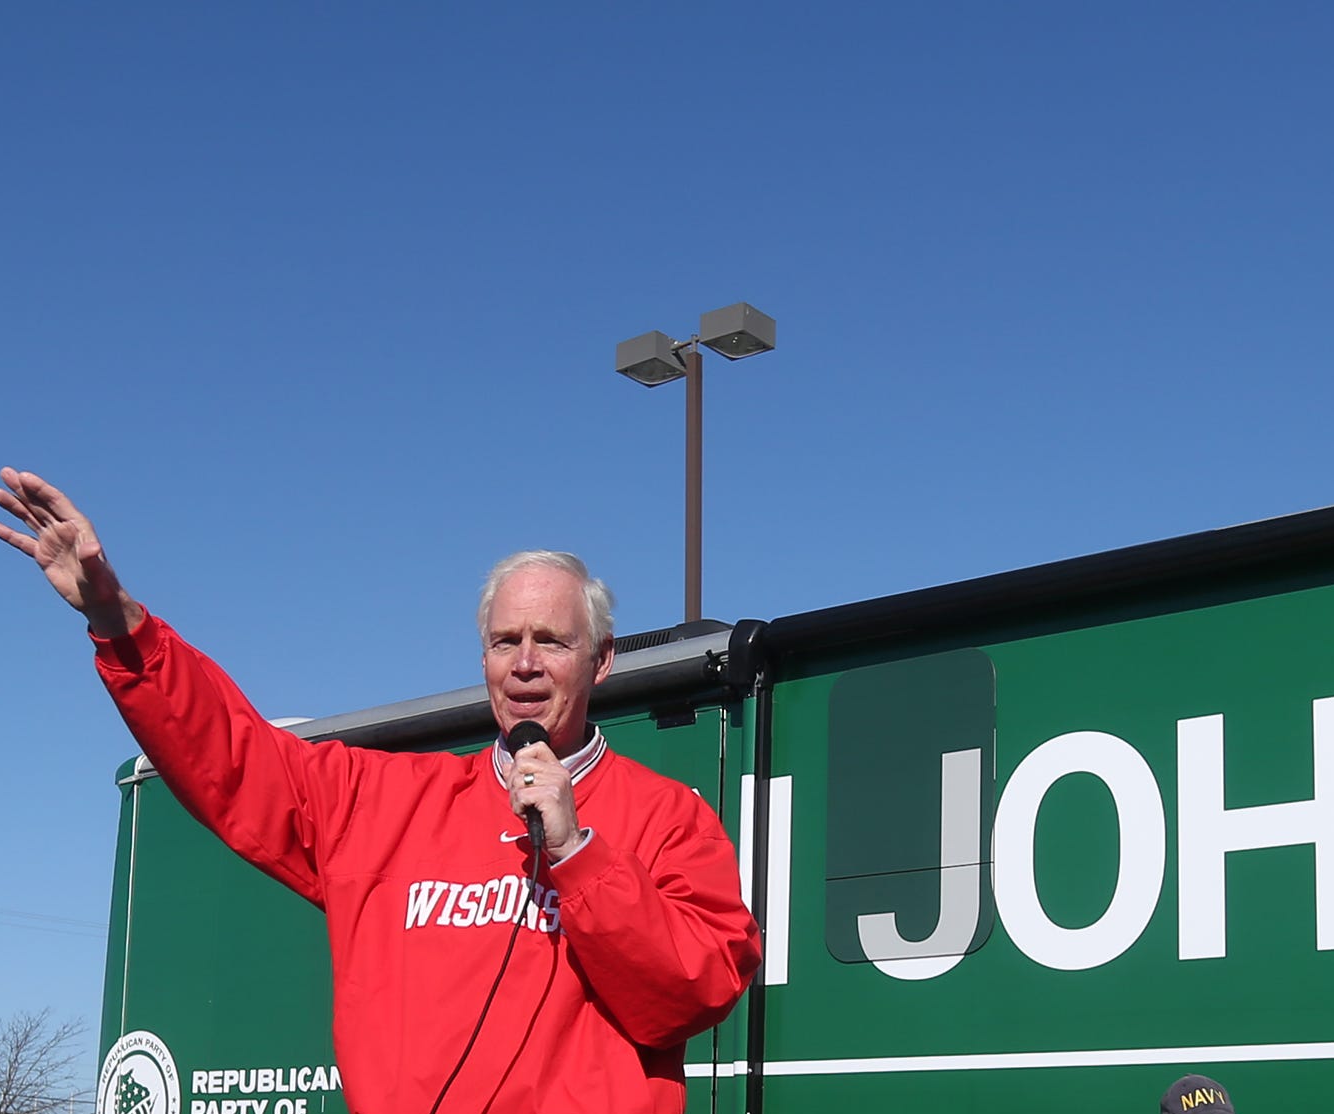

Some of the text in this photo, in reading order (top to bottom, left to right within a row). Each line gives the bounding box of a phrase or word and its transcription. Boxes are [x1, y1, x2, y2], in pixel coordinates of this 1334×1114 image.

[145, 1038, 167, 1062] PARTY
[192, 1066, 343, 1094] REPUBLICAN
[1181, 1088, 1226, 1111] NAVY
